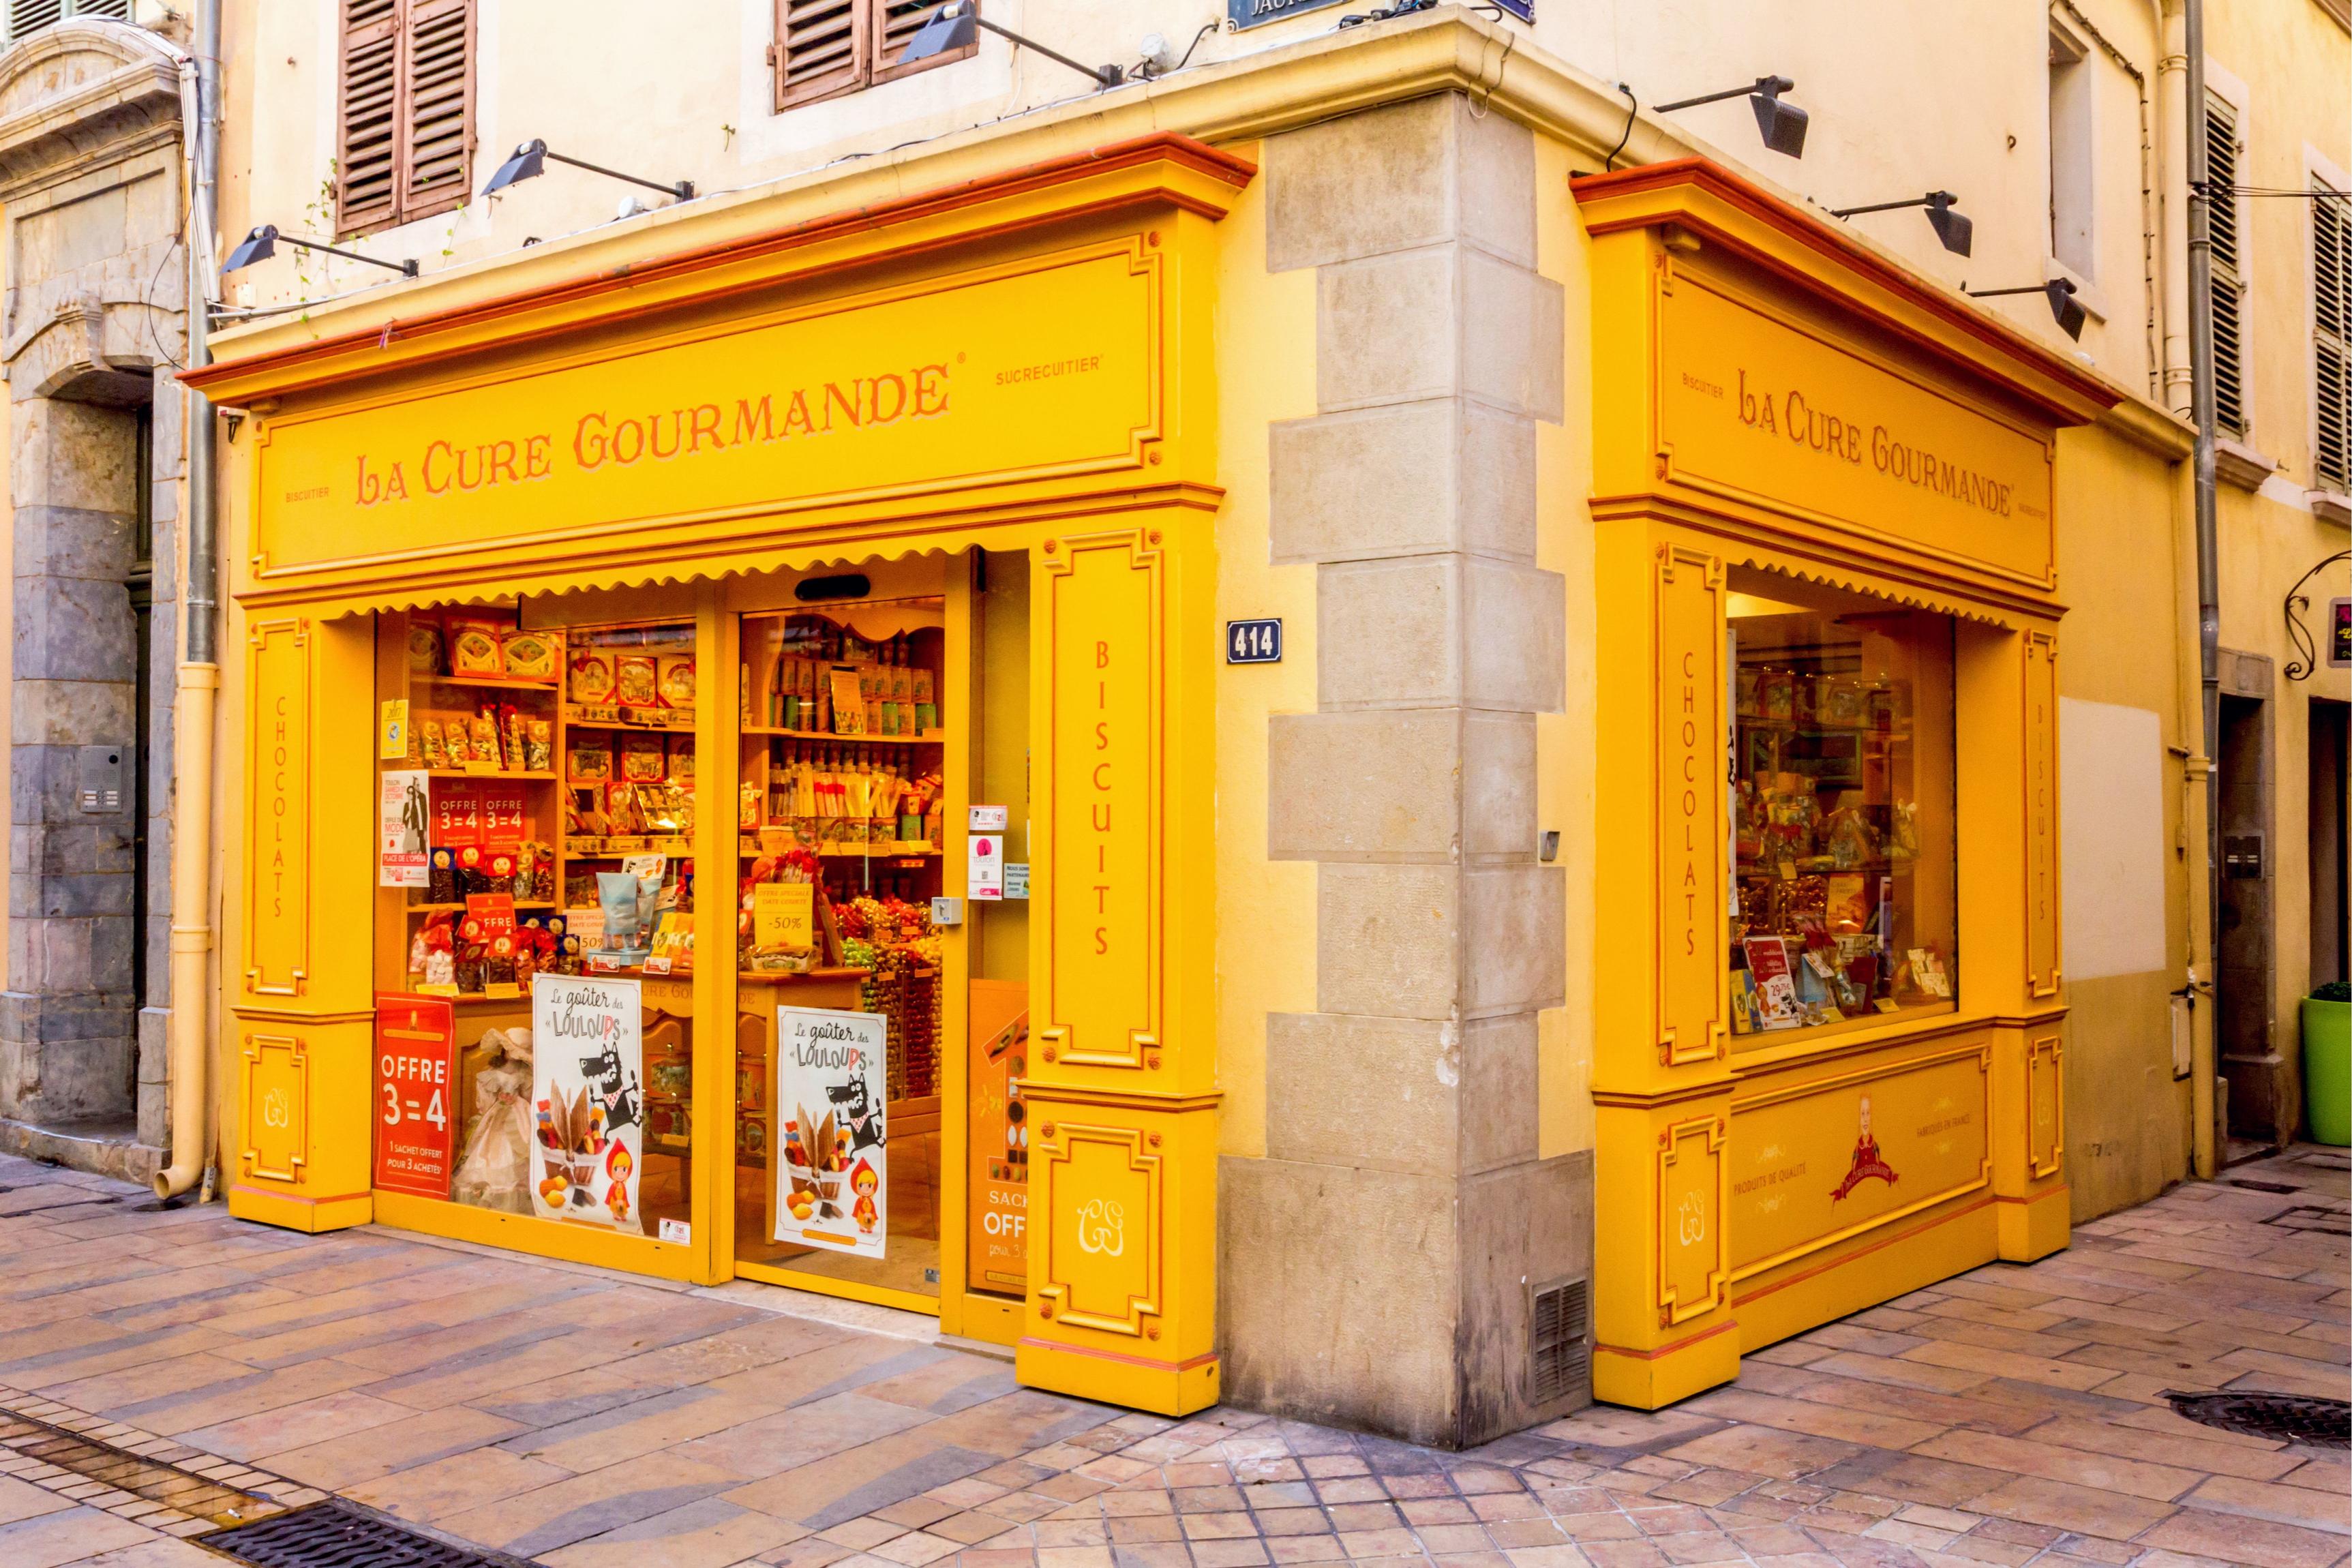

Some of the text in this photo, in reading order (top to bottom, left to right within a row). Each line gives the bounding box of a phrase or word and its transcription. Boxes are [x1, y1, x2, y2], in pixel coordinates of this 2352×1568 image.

[996, 355, 1101, 385] SUCRECUITIER
[1682, 372, 1724, 401] BISCUITIER
[355, 363, 950, 507] LA CURE GOURMANDE
[1737, 368, 2011, 518] LA CURE GOURMANDE
[285, 486, 330, 503] BISCUITIER
[1233, 625, 1273, 659] 414
[273, 695, 287, 918] CHOCOLATS
[440, 800, 477, 811] OFFRE
[486, 800, 522, 810] OFFRE
[1091, 641, 1112, 956] BISCUITS
[1682, 651, 1696, 956] CHOCOLATS
[2037, 704, 2045, 920] BISCUITS
[383, 854, 398, 862] PLACE
[483, 917, 512, 928] FFRE
[768, 917, 802, 929] -50%
[550, 987, 624, 1016] Le goûter des
[794, 1022, 870, 1049] Le goûter des
[381, 1054, 447, 1085] OFFRE
[387, 1158, 406, 1169] POUR
[407, 1158, 413, 1170] 3
[389, 1140, 443, 1160] 1 SACHET OFFERT
[1734, 1175, 1767, 1196] PRODUITS
[1768, 1172, 1777, 1185] DE
[984, 1211, 1026, 1238] OFF
